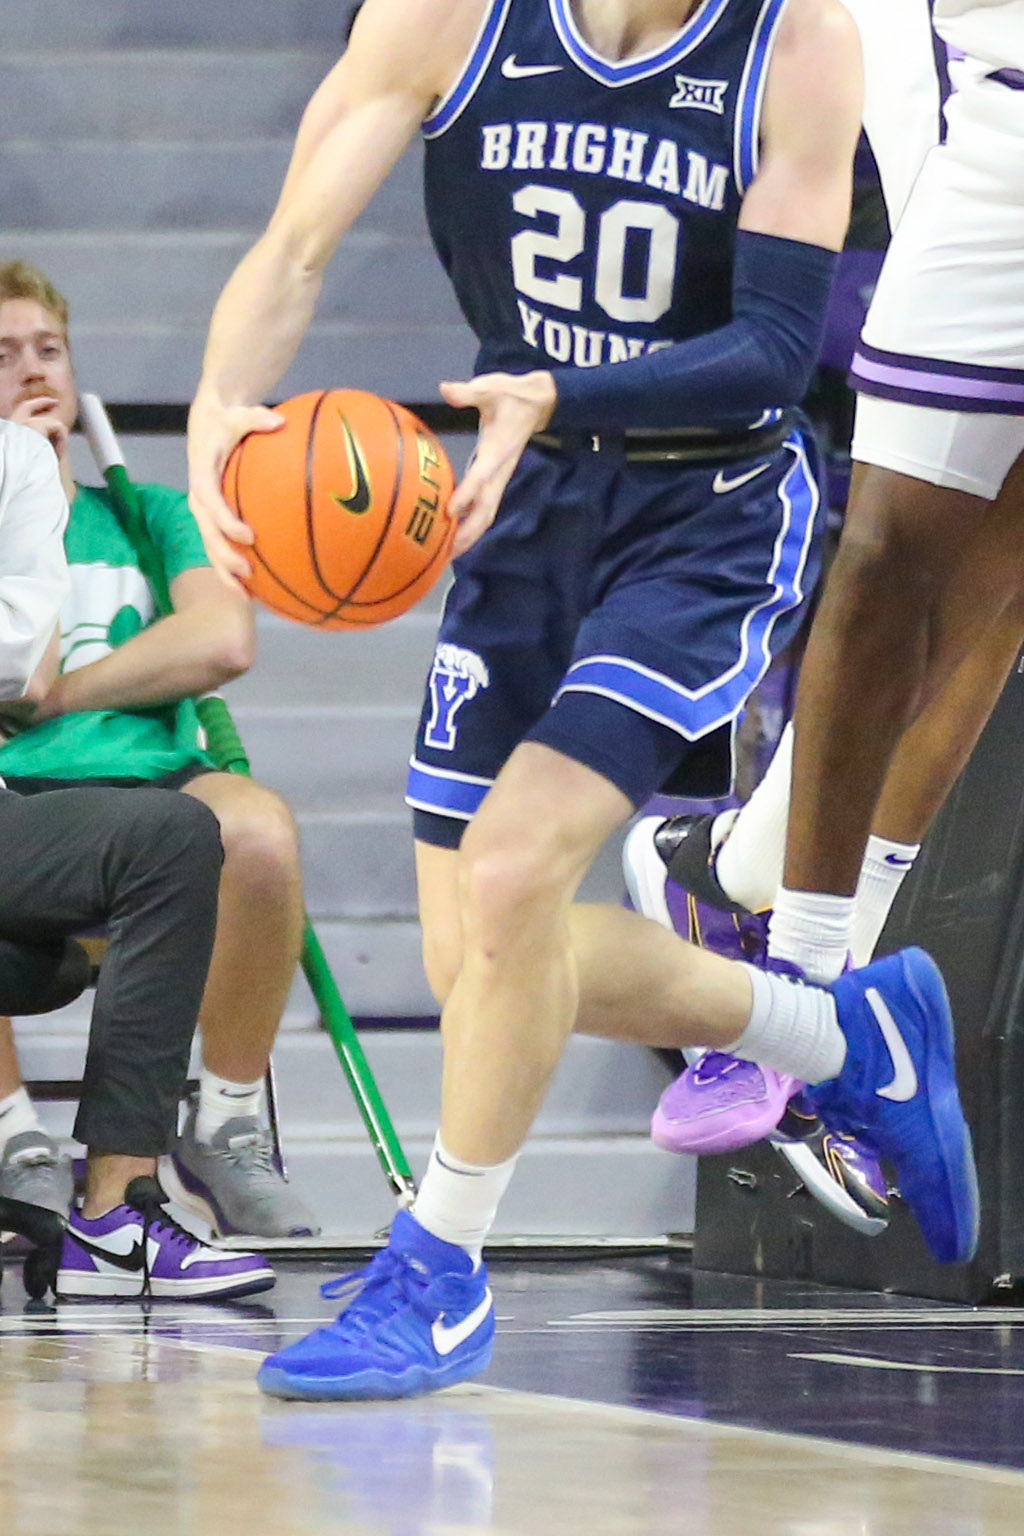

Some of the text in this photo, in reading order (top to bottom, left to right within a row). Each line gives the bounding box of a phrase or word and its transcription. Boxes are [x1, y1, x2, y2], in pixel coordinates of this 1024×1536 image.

[480, 120, 730, 212] BRIGHAM
[511, 183, 681, 324] 20
[516, 298, 675, 369] YOUN
